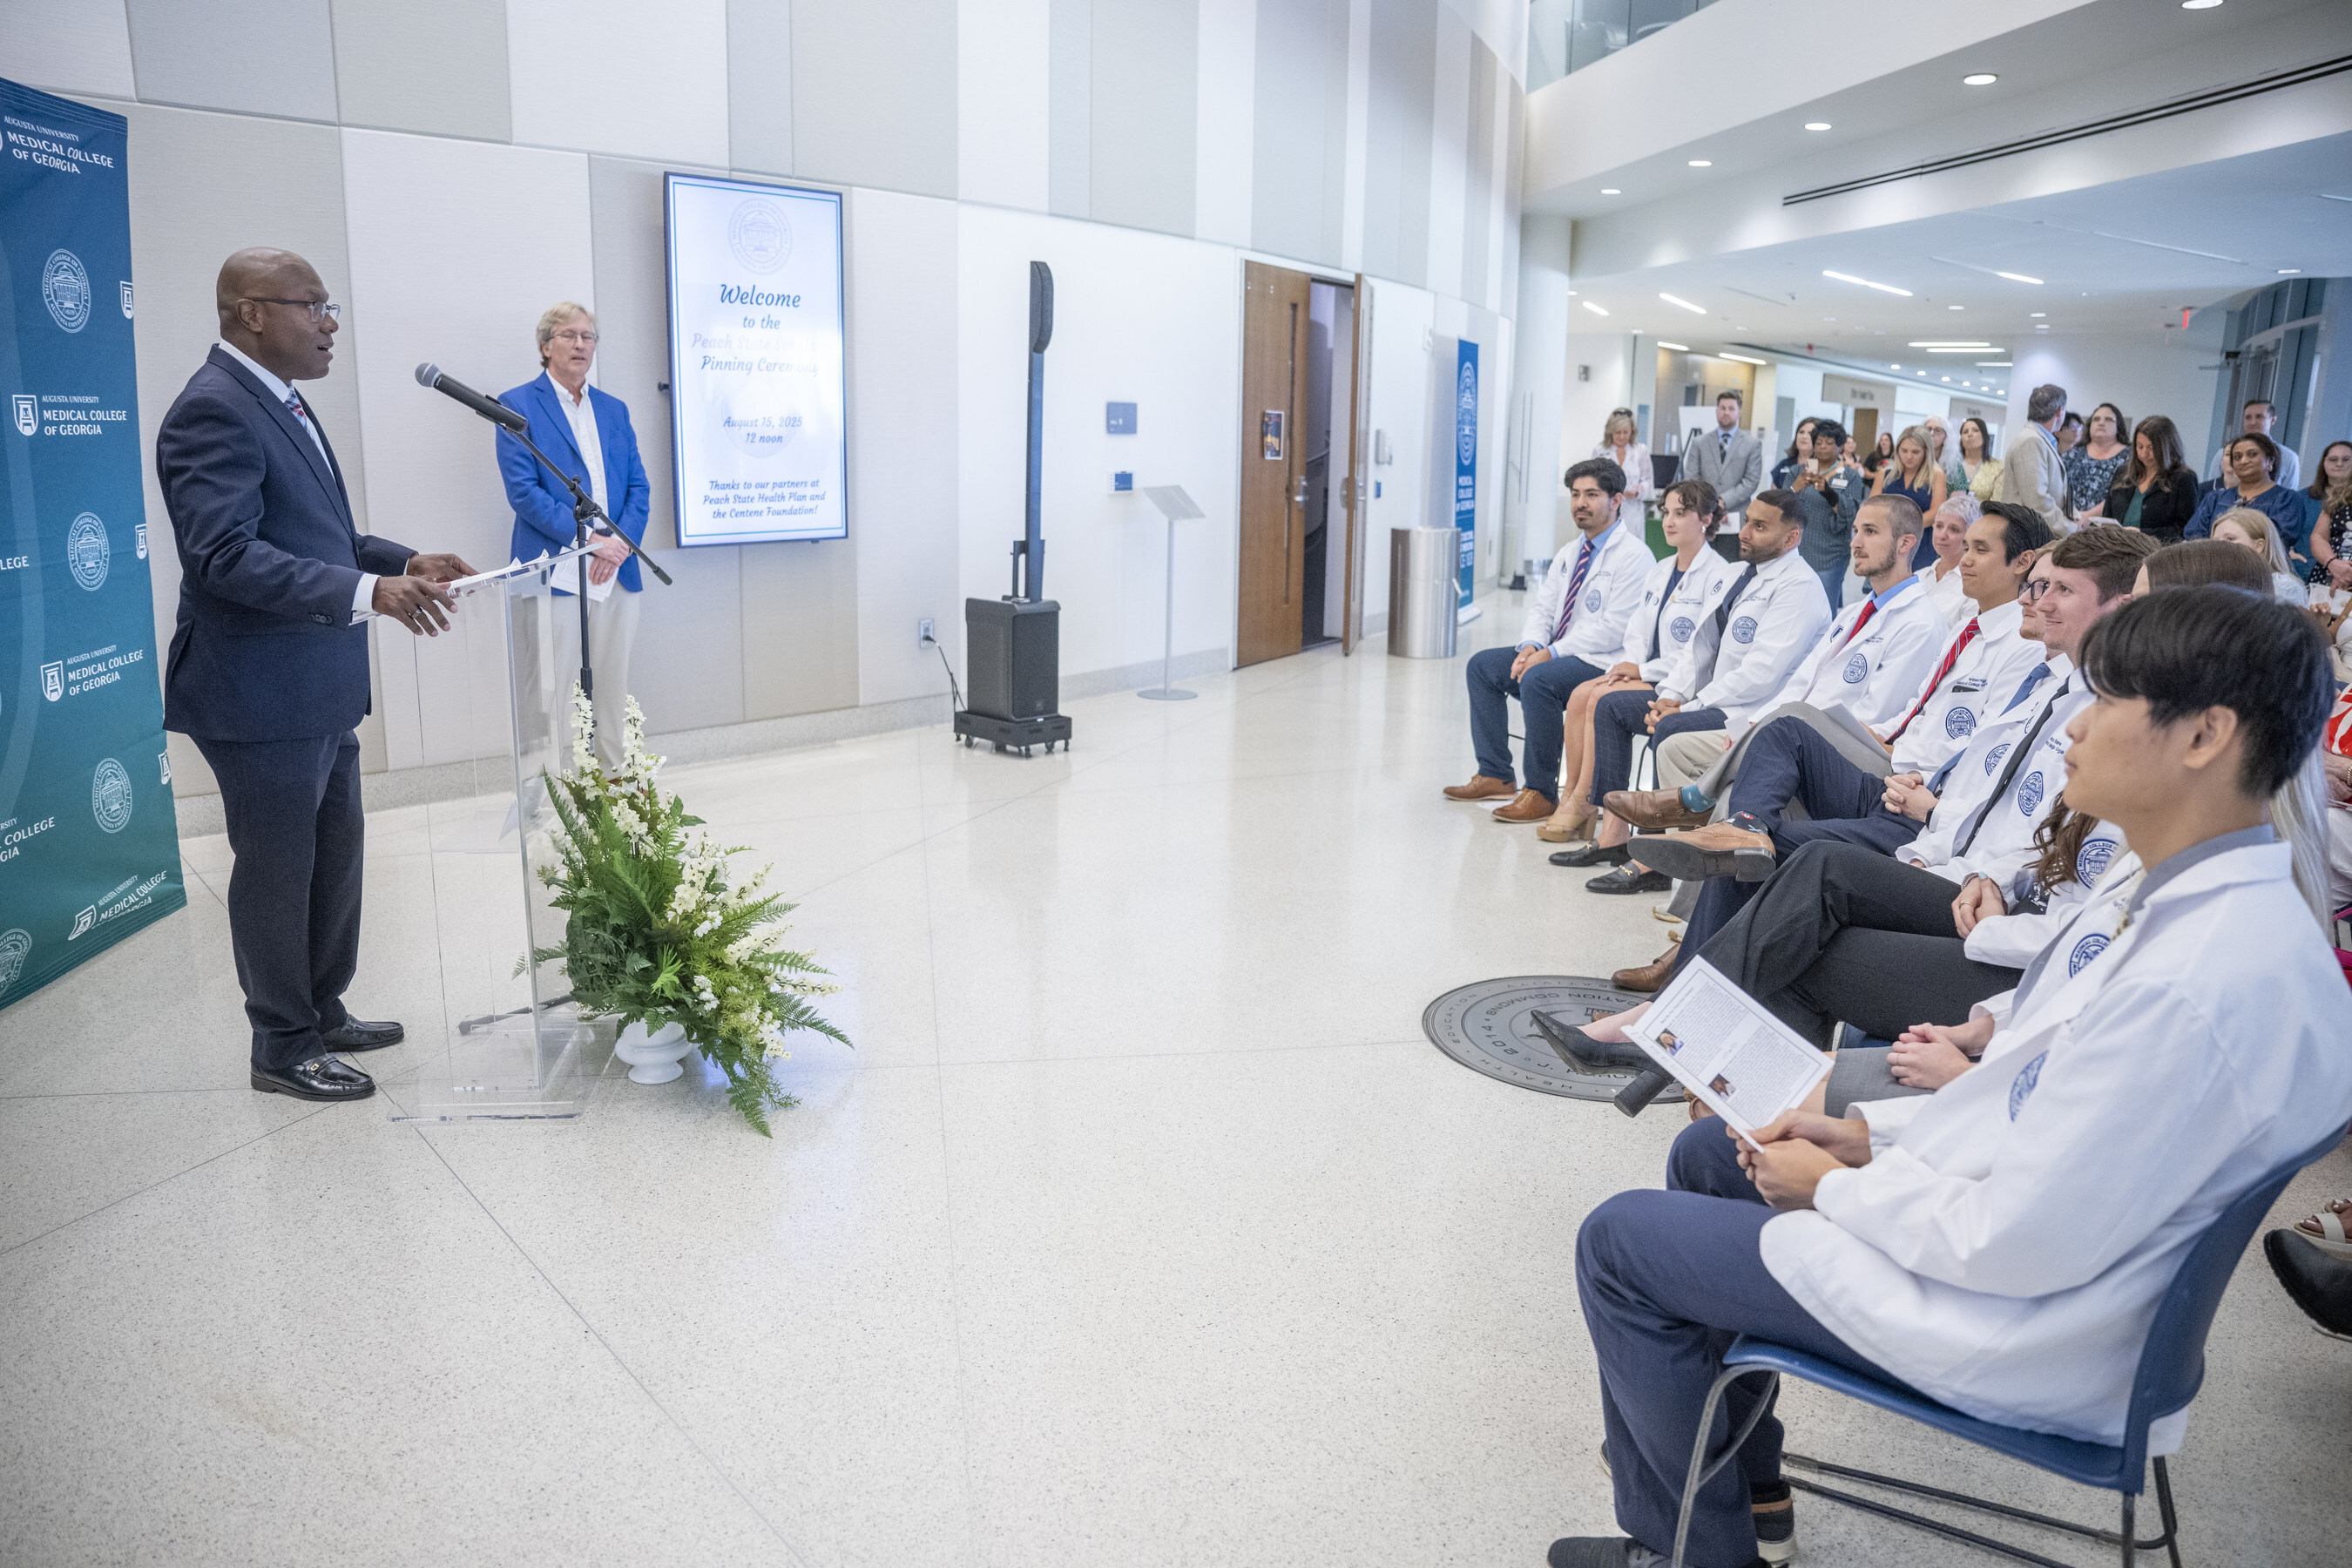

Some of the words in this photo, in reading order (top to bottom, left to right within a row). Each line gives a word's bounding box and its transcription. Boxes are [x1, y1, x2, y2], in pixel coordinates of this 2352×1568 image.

[4, 115, 36, 132] AUGUSTA
[37, 125, 79, 142] UNIVERSITY
[7, 131, 65, 156] MEDICAL
[67, 146, 114, 168] COLLEGE
[12, 148, 29, 160] OF
[32, 152, 81, 174] GEORGIA
[44, 263, 53, 295] MEDICAL
[52, 253, 71, 265] COLLEGE
[720, 284, 801, 308] Welcome
[743, 315, 755, 328] to
[760, 314, 781, 329] the
[691, 333, 732, 348] Peach
[700, 355, 753, 375] Pinning
[43, 409, 88, 421] MEDICAL
[90, 409, 127, 421] COLLEGE
[723, 416, 759, 430] August
[761, 416, 774, 429] 15,
[779, 416, 803, 428] 2025
[44, 426, 57, 436] OF
[59, 424, 102, 436] GEORGIA
[746, 432, 757, 443] 12
[759, 435, 783, 443] noon
[709, 479, 740, 490] Thanks
[743, 481, 753, 490] to
[755, 481, 770, 490] our
[771, 480, 808, 491] partners
[810, 479, 820, 488] at
[703, 494, 730, 505] Peach
[733, 494, 755, 504] State
[757, 492, 786, 503] Health
[788, 491, 807, 502] Plan
[810, 490, 826, 501] and
[713, 508, 727, 519] the
[729, 508, 764, 518] Centene
[767, 504, 818, 517] Foundation!
[76, 517, 92, 529] COLLEGE
[67, 652, 91, 665] AUGUSTA
[91, 645, 117, 659] UNIVERSITY
[68, 662, 107, 682] MEDICAL
[108, 649, 144, 669] COLLEGE
[70, 685, 81, 696] OF
[83, 671, 121, 692] GEORGIA
[4, 816, 55, 845] COLLEGE
[2078, 848, 2089, 868] MEDICAL
[2080, 871, 2094, 886] AUGUST
[98, 890, 118, 907] AUGUSTA
[115, 874, 139, 894] UNIVERSITY
[99, 893, 139, 922] MEDICAL
[136, 870, 167, 896] COLLEGE
[1486, 992, 1559, 1017] COMMONS
[1568, 992, 1639, 1006] CATION
[1444, 994, 1477, 1044] EDUCATION
[1481, 1025, 1518, 1055] 2014
[1480, 1058, 1572, 1090] HEALTH
